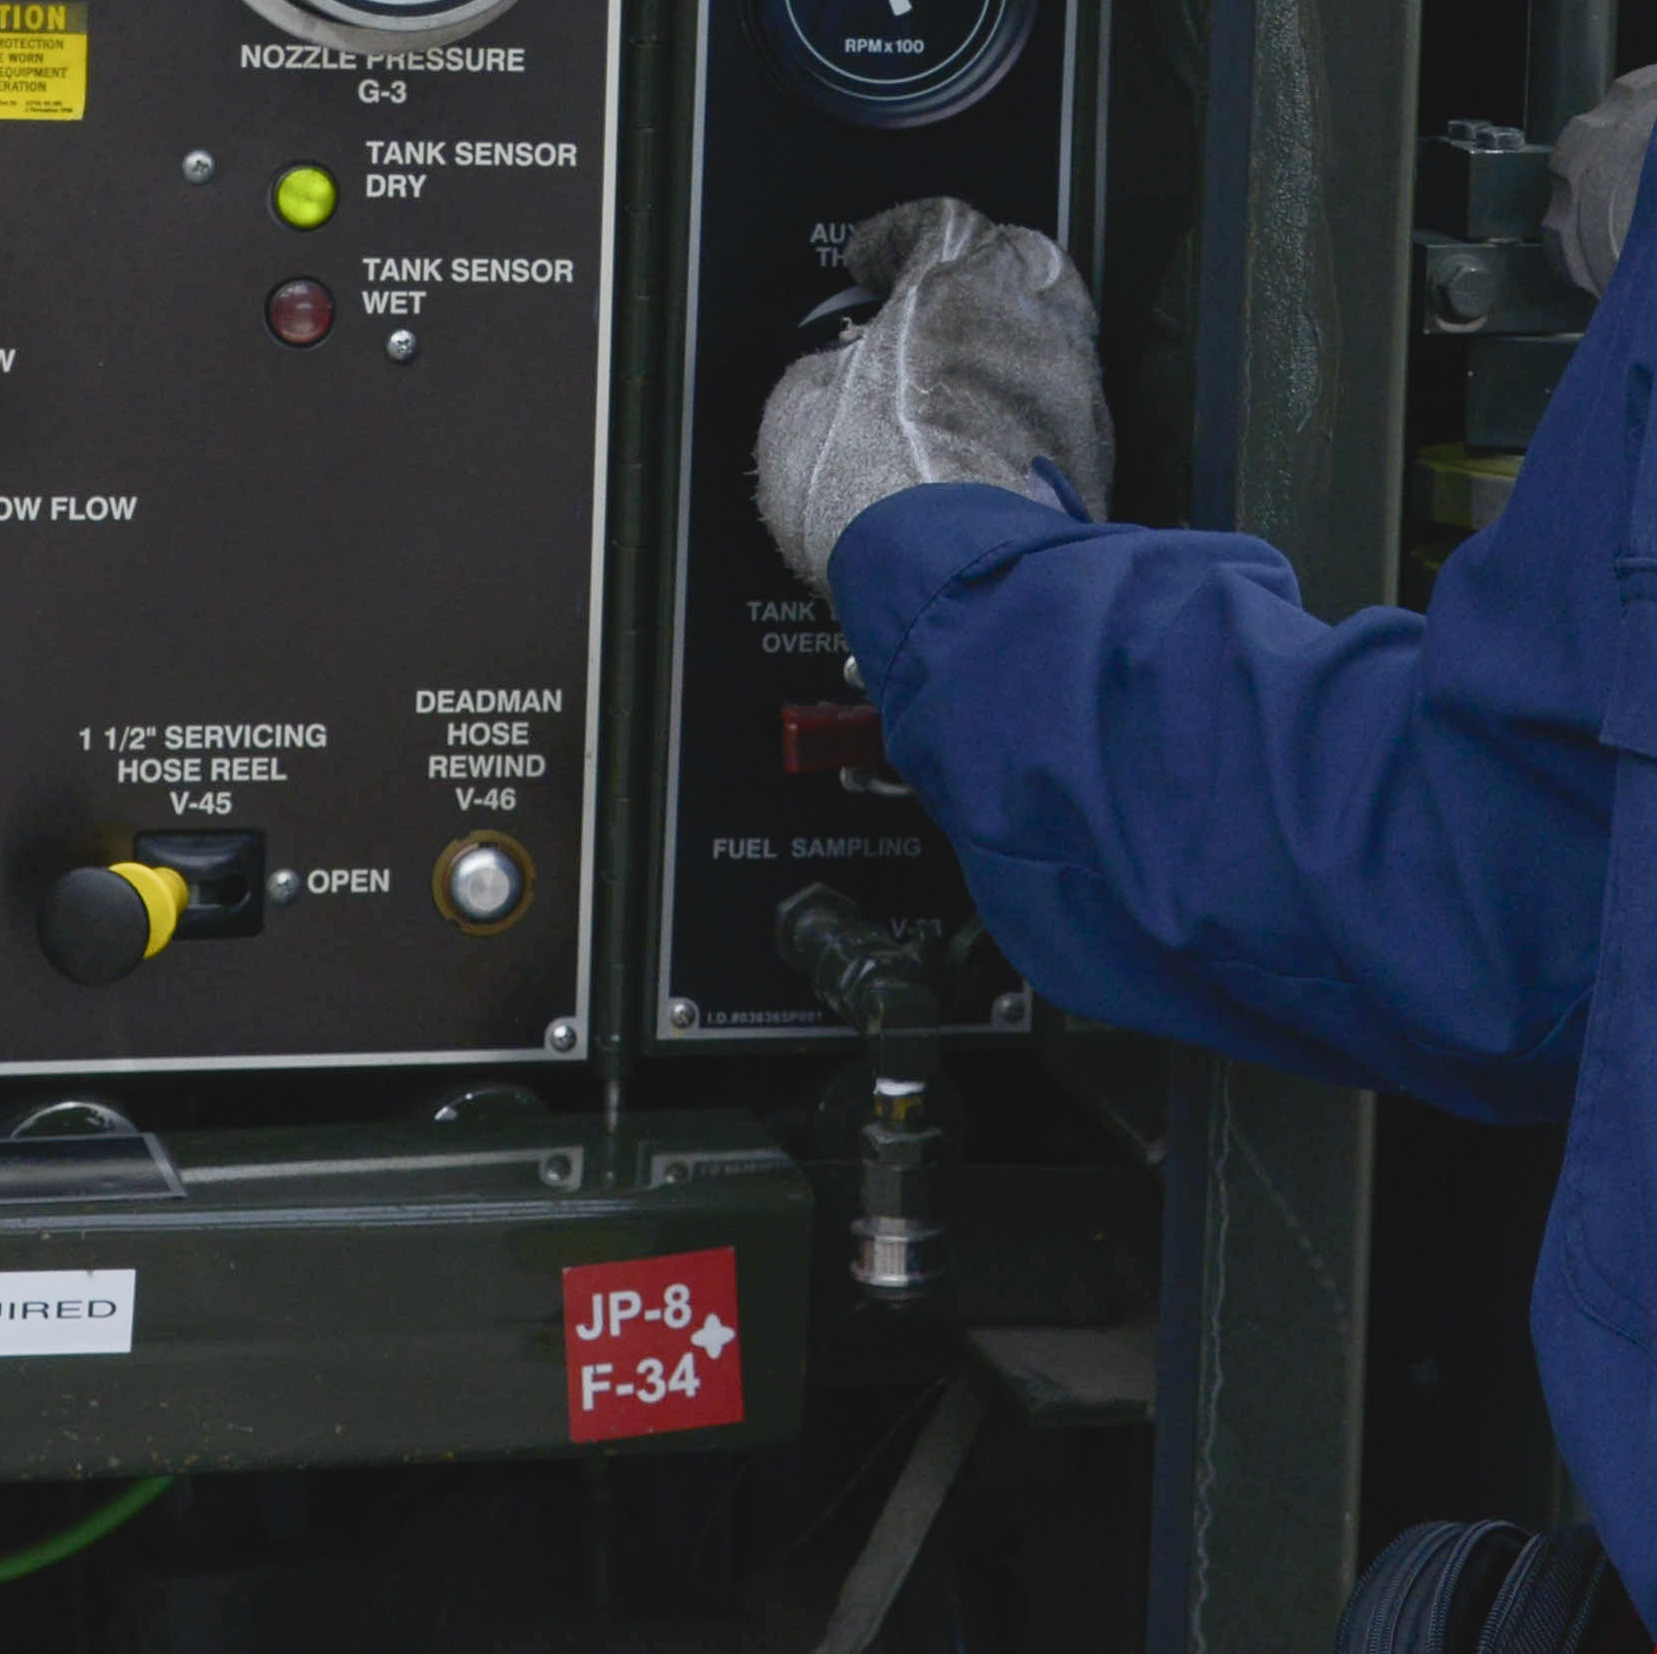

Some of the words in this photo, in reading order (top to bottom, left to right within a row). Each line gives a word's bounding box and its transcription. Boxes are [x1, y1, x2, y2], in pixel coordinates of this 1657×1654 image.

[8, 52, 44, 63] WORN
[240, 43, 357, 70] NOZZLE
[366, 46, 526, 72] PRESSURE
[357, 80, 408, 104] G-3
[366, 141, 447, 166] TANK
[454, 143, 578, 167] SENSOR
[366, 174, 427, 198] DRY
[362, 258, 444, 282] TANK
[450, 259, 574, 283] SENSOR
[362, 291, 427, 315] WET
[50, 497, 138, 521] FLOW
[747, 602, 815, 622] TANK
[415, 689, 564, 715] DEADMAN
[78, 727, 92, 751] 1
[103, 725, 159, 752] 1/2"
[164, 722, 329, 749] SERVICING
[447, 721, 530, 747] HOSE
[117, 757, 203, 784] HOSE
[210, 756, 288, 782] REEL
[428, 753, 546, 780] REWIND
[169, 791, 233, 816] V-45
[454, 787, 518, 812] V-46
[713, 838, 777, 859] FUEL
[791, 837, 922, 859] SAMPLING
[307, 867, 391, 894] OPEN
[575, 1282, 692, 1341] JP-8
[580, 1350, 702, 1412] F-34
